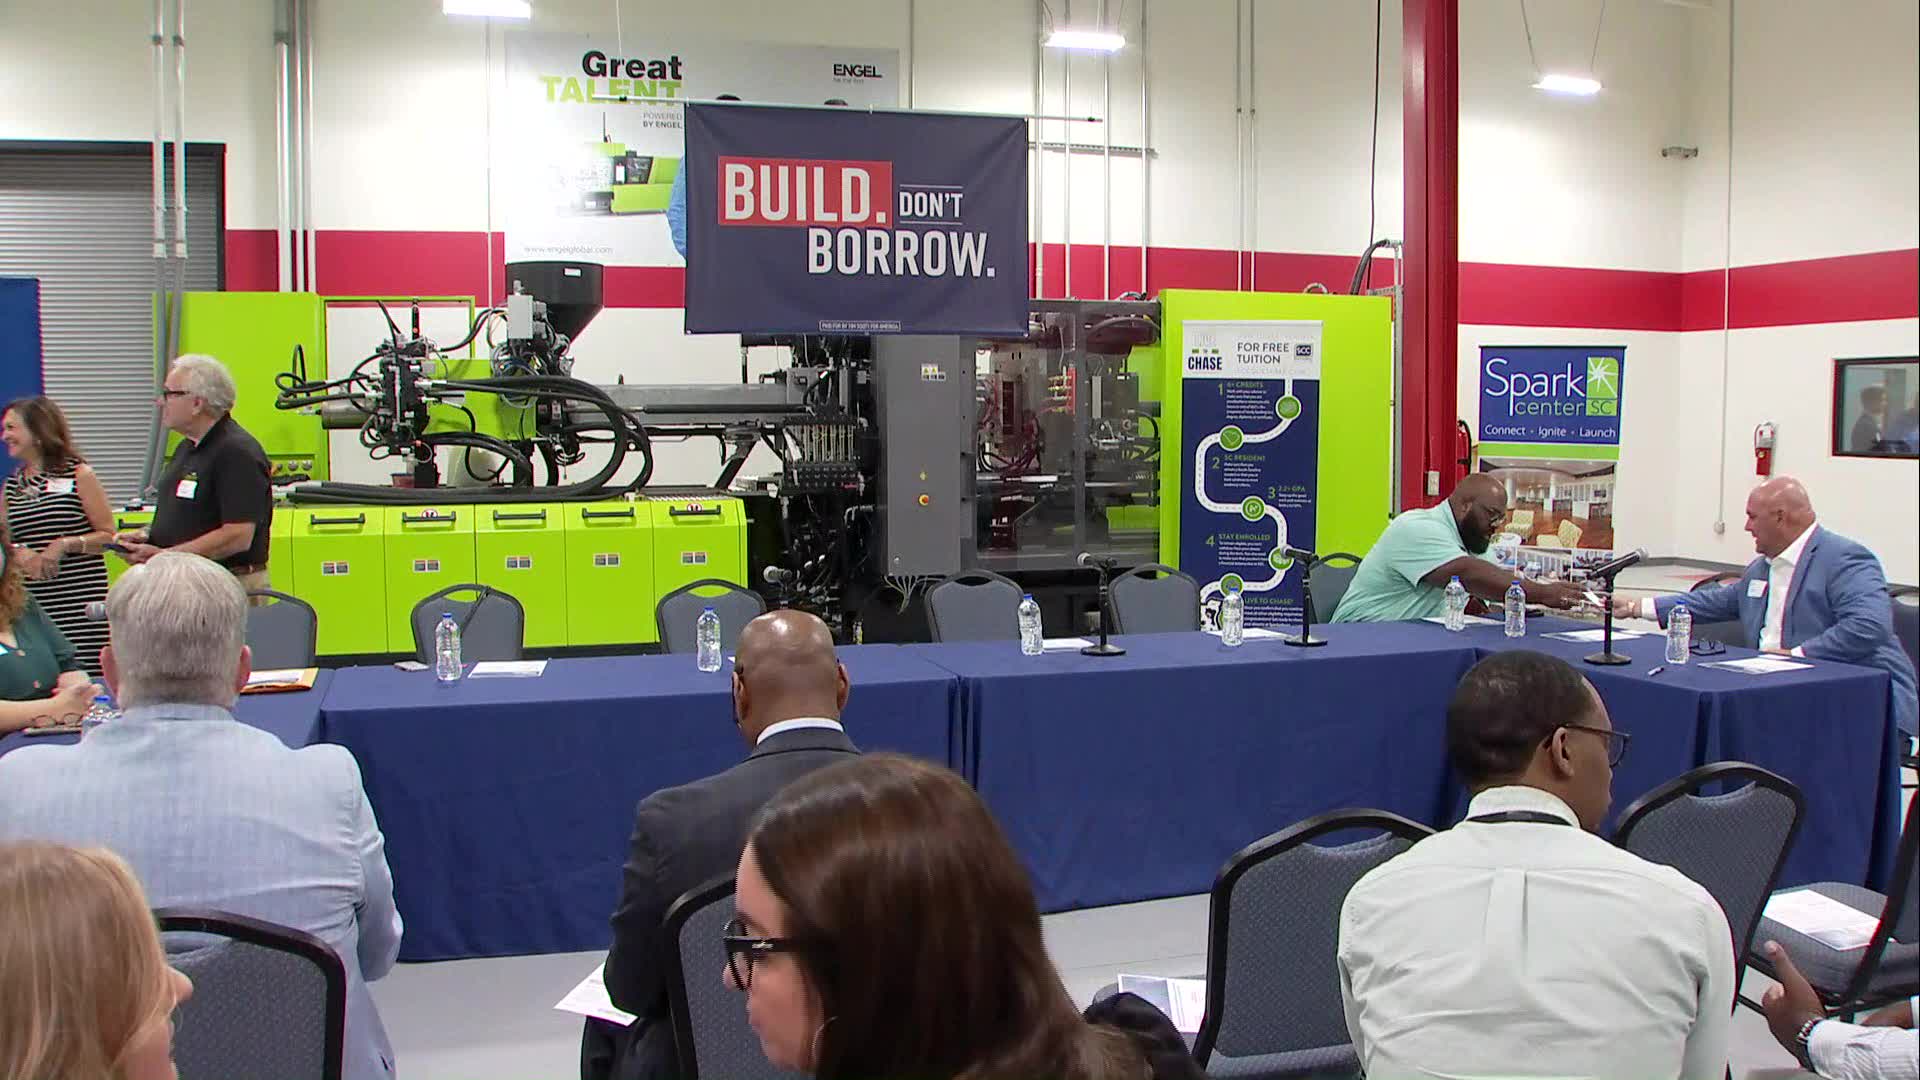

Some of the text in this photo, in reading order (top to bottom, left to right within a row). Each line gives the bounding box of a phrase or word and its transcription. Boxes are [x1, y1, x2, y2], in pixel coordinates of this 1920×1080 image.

[582, 50, 682, 80] Great
[833, 63, 882, 78] ENGEL
[541, 75, 682, 107] TALENT
[643, 112, 682, 121] POWERED
[725, 163, 963, 224] BUILD. DON'T
[807, 227, 996, 278] BORROW.
[1237, 342, 1289, 353] FOR FREE
[1188, 356, 1223, 370] CHASE
[1236, 354, 1281, 364] TUITION
[1218, 383, 1224, 396] 1
[1485, 358, 1586, 416] Spark
[1515, 400, 1612, 416] center SC
[1485, 424, 1616, 439] Connect Ignite Launch
[1212, 457, 1221, 470] 2
[1268, 486, 1277, 499] 3
[1205, 535, 1216, 547] 4
